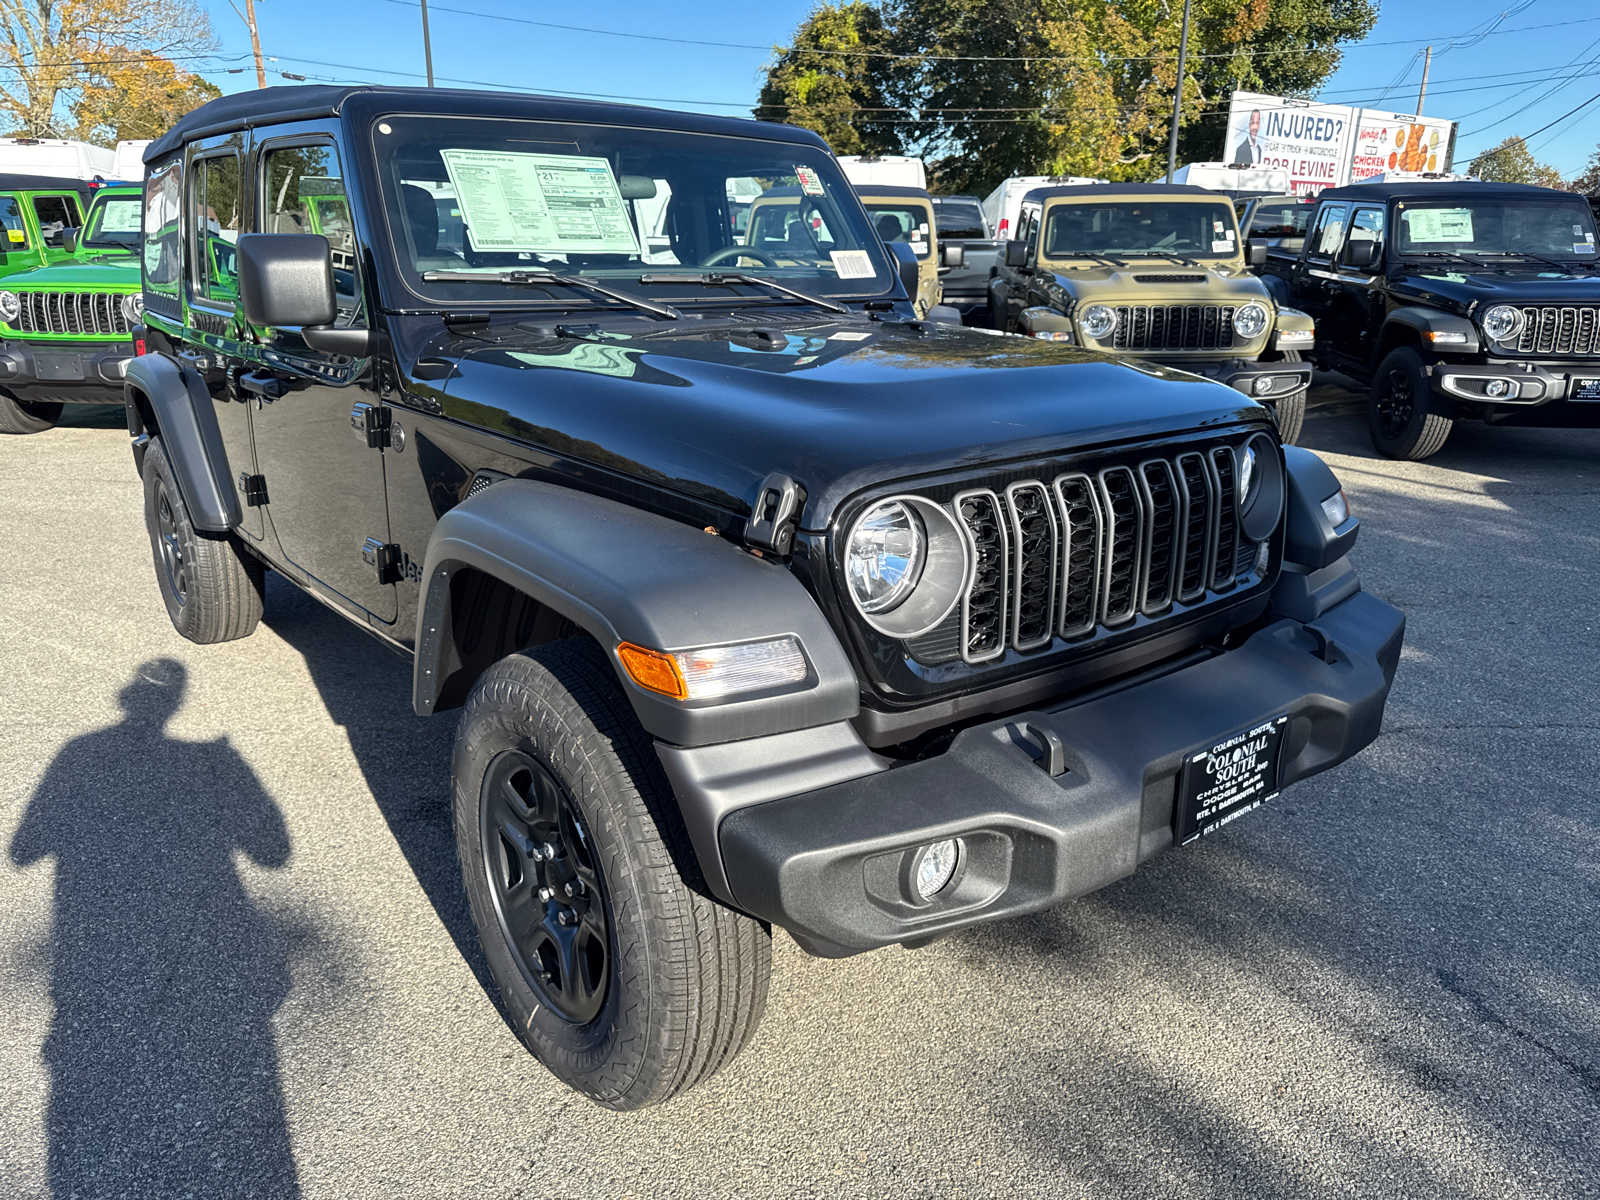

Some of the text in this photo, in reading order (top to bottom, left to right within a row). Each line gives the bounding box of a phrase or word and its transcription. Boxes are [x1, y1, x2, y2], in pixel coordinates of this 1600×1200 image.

[1266, 111, 1343, 143] INJURED?
[542, 172, 553, 181] 21
[1291, 159, 1336, 178] LEVINE
[1353, 155, 1386, 167] CHICKEN
[1213, 721, 1272, 754] COLONIAL SOUTH
[1205, 735, 1268, 774] COLONIAL
[1215, 753, 1257, 785] SOUTH
[1196, 760, 1269, 801] CHRYSLER Jeep
[1202, 773, 1261, 807] DODGE RAM
[1196, 780, 1265, 821] RTE. 6 DARTMOUTH, MA
[1203, 826, 1215, 836] RTE.
[1215, 821, 1220, 829] 6
[1252, 799, 1261, 809] MA
